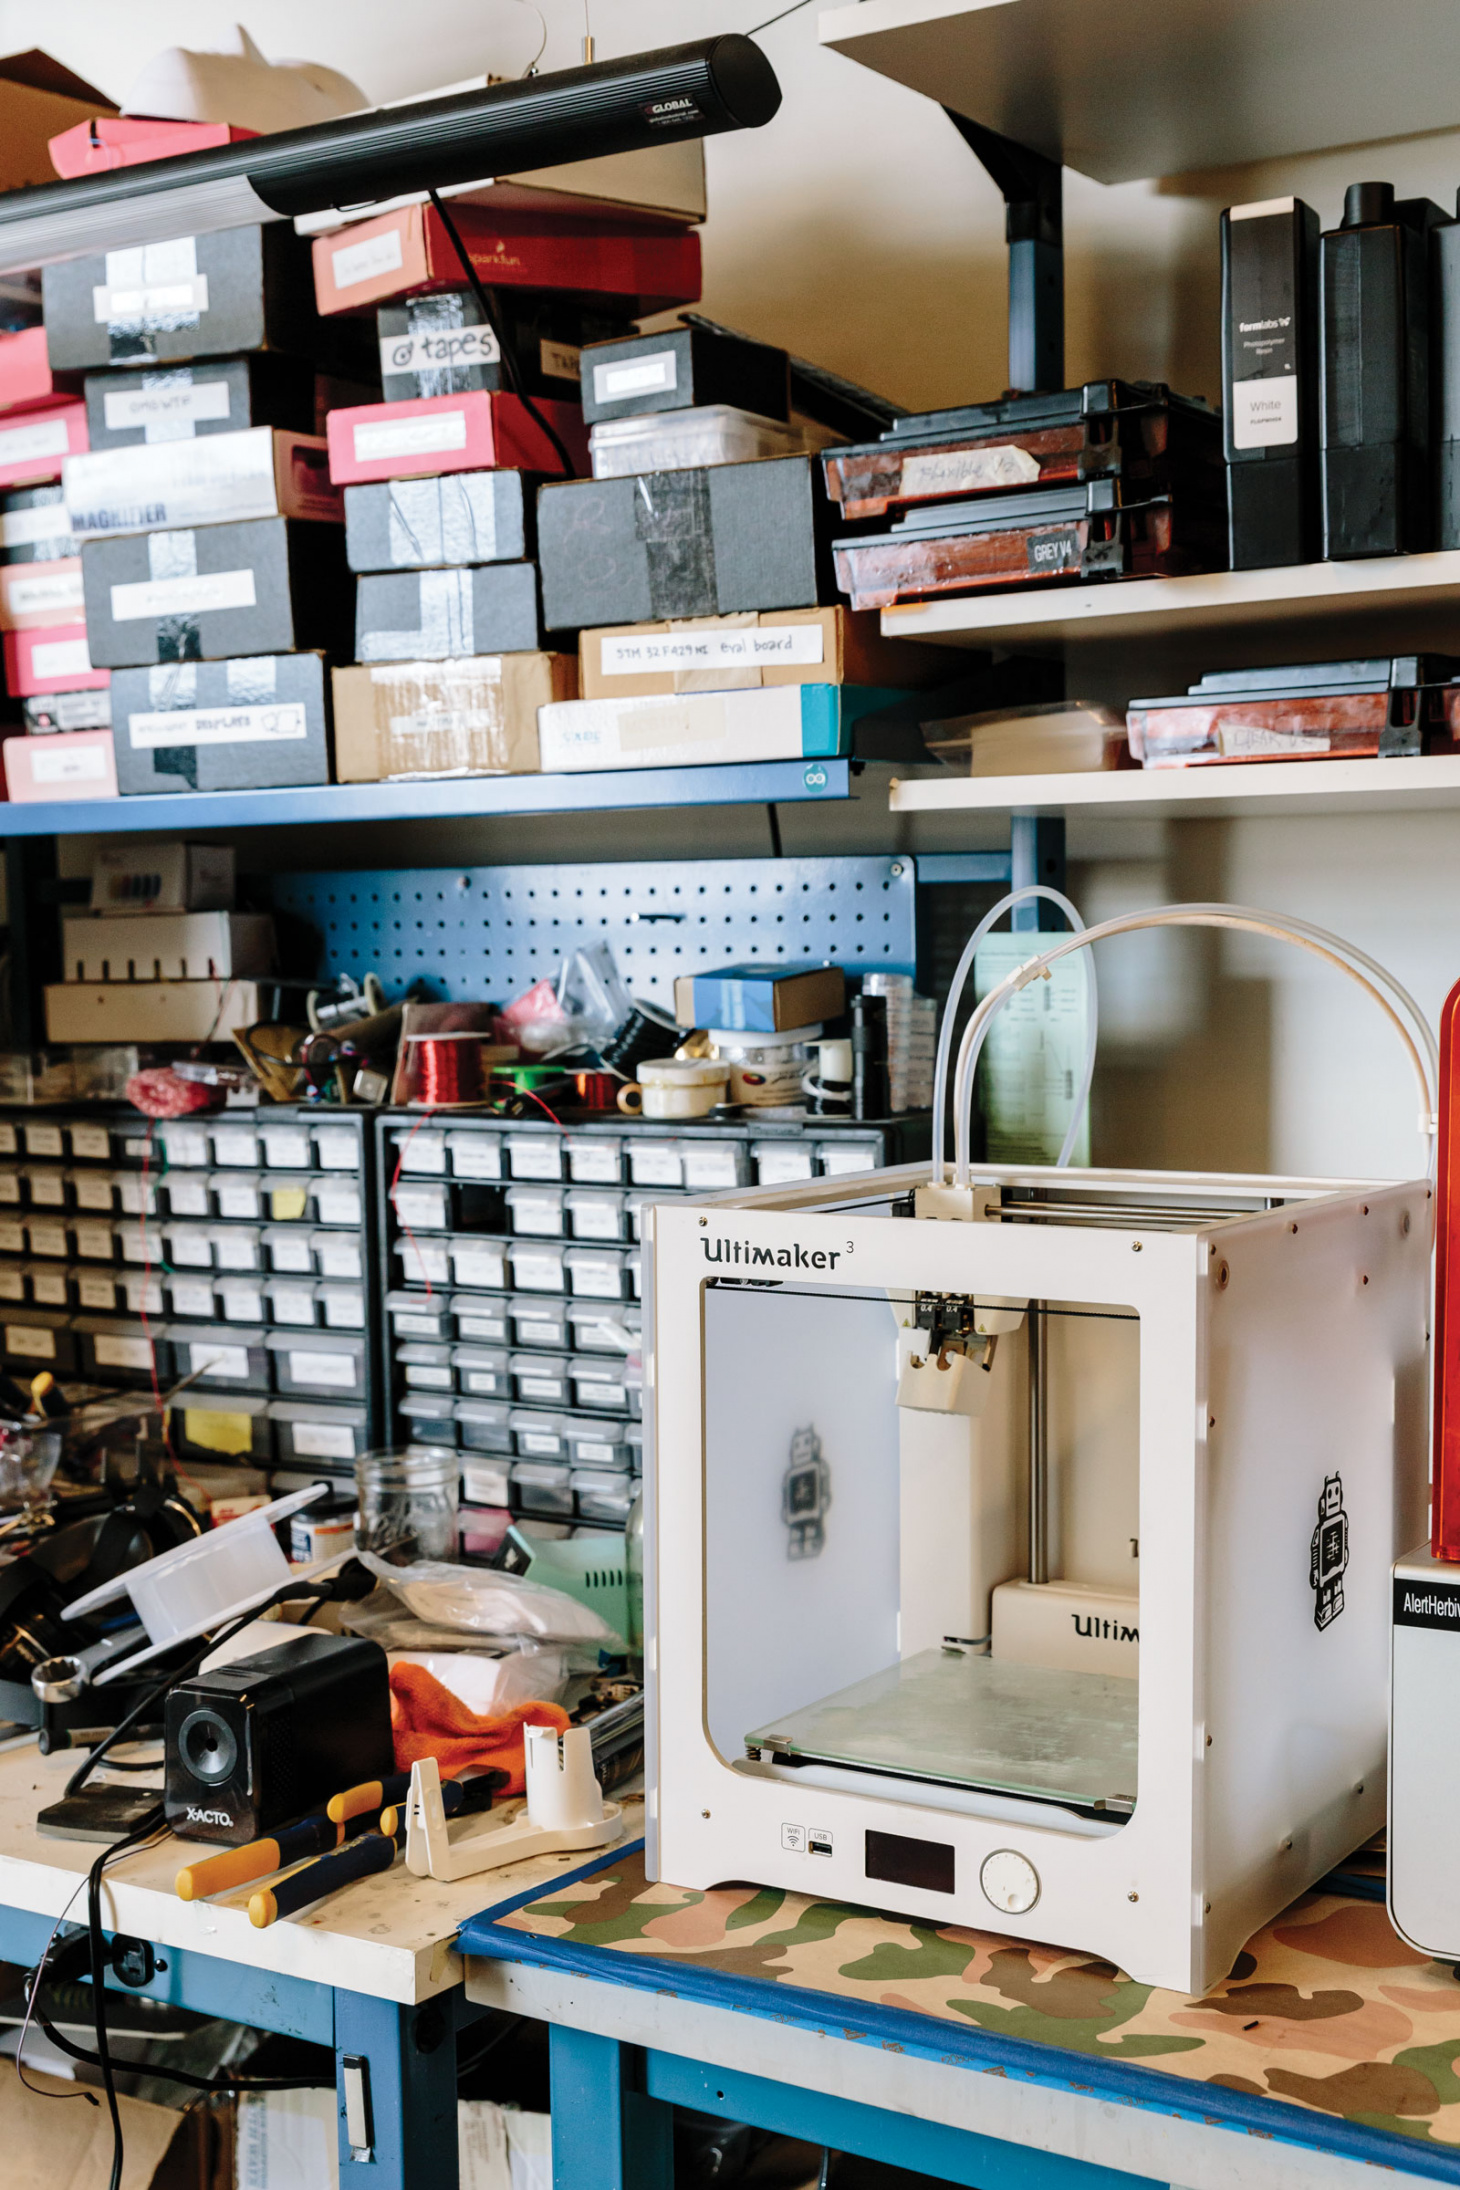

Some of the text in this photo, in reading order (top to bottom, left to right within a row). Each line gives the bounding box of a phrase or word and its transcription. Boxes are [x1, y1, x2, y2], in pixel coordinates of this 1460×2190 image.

[652, 98, 693, 113] GLOBAL
[1239, 319, 1279, 332] formlabs
[421, 332, 493, 363] tapes
[1250, 400, 1282, 412] White
[1034, 540, 1072, 562] GREY V4
[720, 638, 746, 653] eval
[754, 634, 792, 651] board
[700, 1237, 854, 1270] Ultimaker 3
[920, 1303, 933, 1313] 0.4
[946, 1305, 958, 1313] 0.4
[813, 1832, 828, 1841] USB
